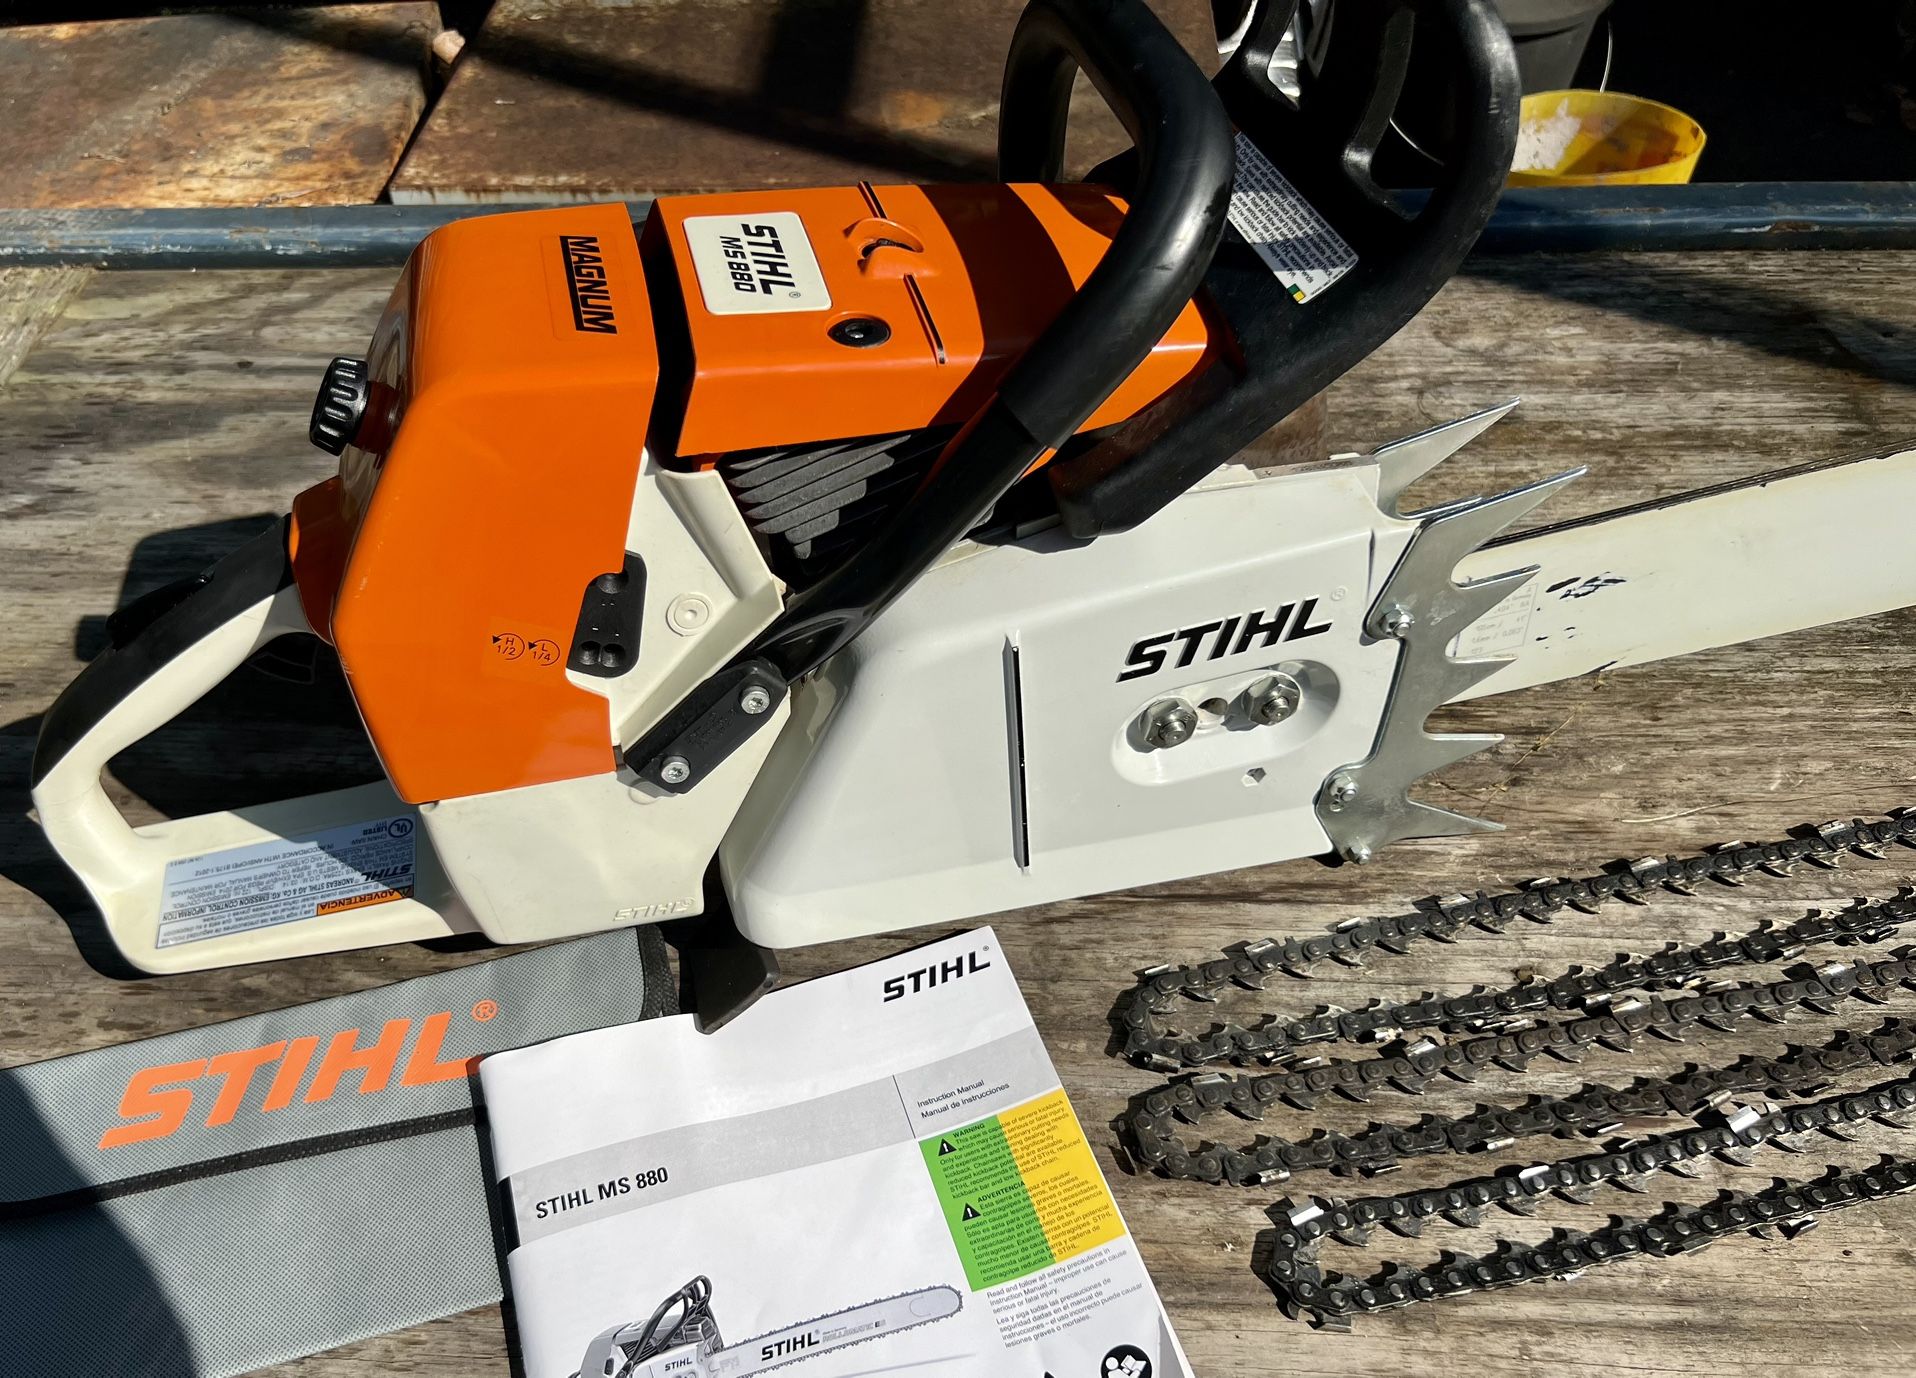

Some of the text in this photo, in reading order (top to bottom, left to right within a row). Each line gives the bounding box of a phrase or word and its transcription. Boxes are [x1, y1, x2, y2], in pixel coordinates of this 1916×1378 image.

[719, 235, 757, 293] MS 880
[741, 223, 796, 295] STIHL
[567, 235, 617, 334] MAGNUM
[497, 645, 516, 655] 1/2
[505, 637, 514, 645] H
[541, 643, 547, 652] L
[1116, 596, 1334, 683] STIHL
[533, 651, 551, 661] 1/4
[360, 862, 412, 882] STIHL
[319, 888, 395, 911] ADVERTENCIA
[612, 901, 688, 922] STIHL
[883, 951, 991, 1003] STIHL
[97, 1011, 480, 1150] STIHL
[916, 1078, 985, 1109] Instruction Manual
[920, 1081, 1010, 1119] Manual de instrucciones
[952, 1121, 985, 1139] WARNING
[535, 1166, 669, 1219] STIHL MS 880
[976, 1179, 1026, 1203] ADVERTENCIA
[761, 1332, 820, 1361] STIHL
[664, 1357, 693, 1372] STIHL
